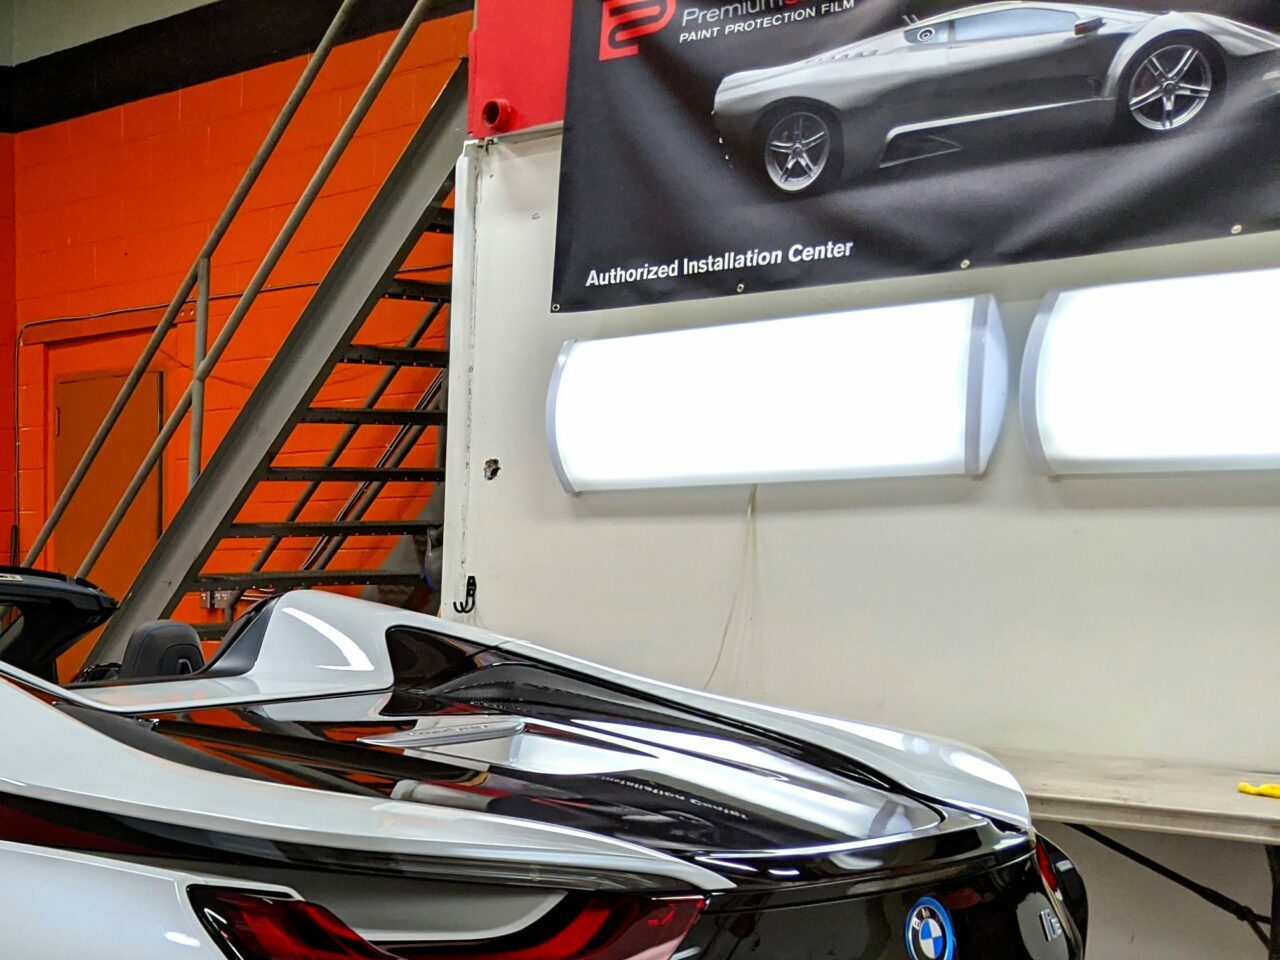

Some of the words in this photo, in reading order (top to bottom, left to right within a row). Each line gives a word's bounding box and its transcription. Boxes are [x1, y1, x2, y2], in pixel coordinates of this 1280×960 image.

[679, 27, 720, 43] PAINT
[724, 7, 816, 35] PROTECTION
[821, 0, 855, 15] FILM
[682, 0, 797, 26] Premium
[585, 259, 679, 287] Authorized
[683, 249, 782, 275] Installation
[788, 241, 854, 263] Center
